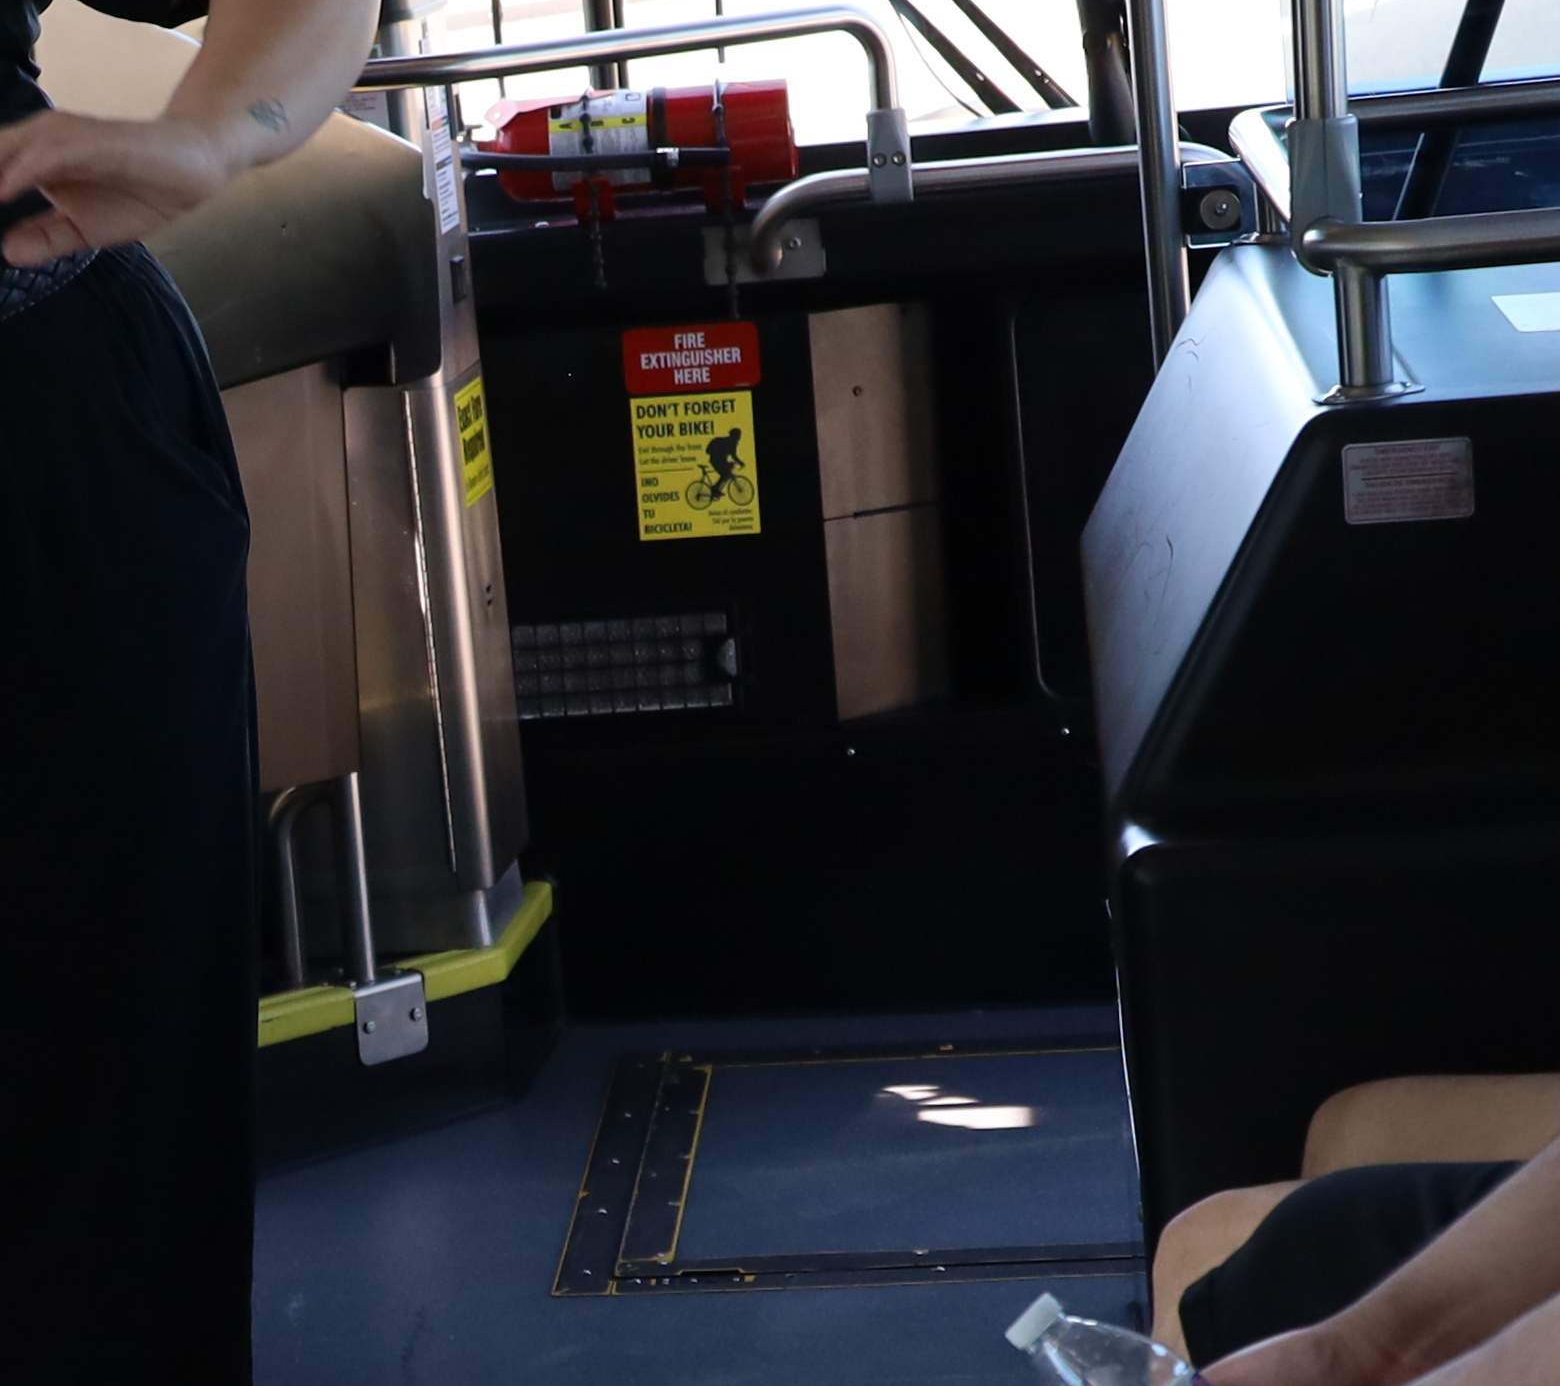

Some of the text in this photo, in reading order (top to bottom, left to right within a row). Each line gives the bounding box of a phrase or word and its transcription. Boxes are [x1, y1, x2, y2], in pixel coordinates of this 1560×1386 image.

[674, 332, 705, 350] FIRE
[640, 347, 741, 370] EXTINGUISHER
[674, 367, 710, 385] HERE
[636, 399, 734, 418] DON'T FORGET
[636, 421, 713, 438] YOUR BIKE!
[642, 491, 679, 503] OLVIDES
[644, 522, 691, 534] BICICLETA!
